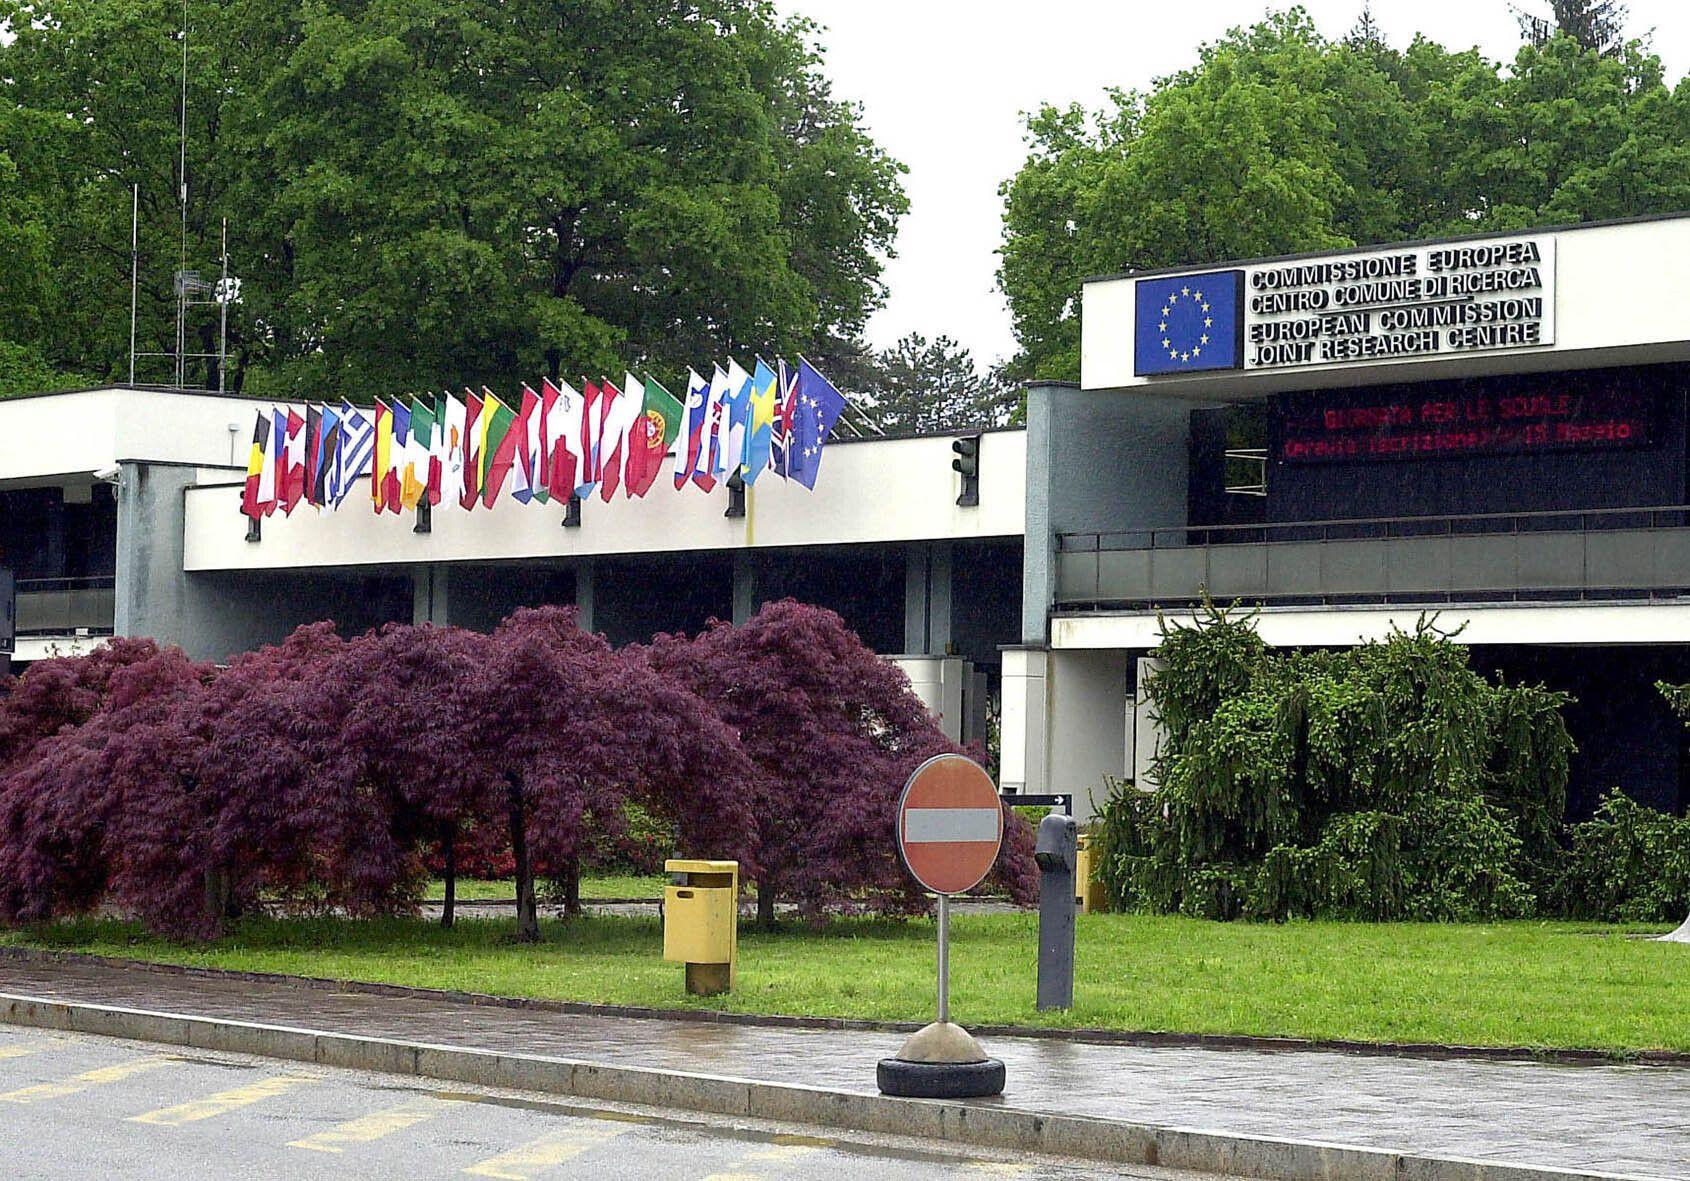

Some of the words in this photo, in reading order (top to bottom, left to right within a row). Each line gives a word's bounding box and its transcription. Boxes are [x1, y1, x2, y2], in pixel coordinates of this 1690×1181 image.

[1251, 256, 1415, 290] COMMISSIONE
[1427, 242, 1540, 272] EUROPEA
[1251, 289, 1325, 314] CENTRO
[1333, 279, 1420, 306] COMUNE
[1424, 276, 1447, 297] DI
[1449, 266, 1541, 294] RICERCA
[1249, 313, 1370, 343] EUROPEAN
[1379, 298, 1541, 331] COMMISSION
[1249, 342, 1311, 365] JOINT
[1320, 331, 1438, 359] RESEARCH
[1447, 322, 1539, 348] CENTRE
